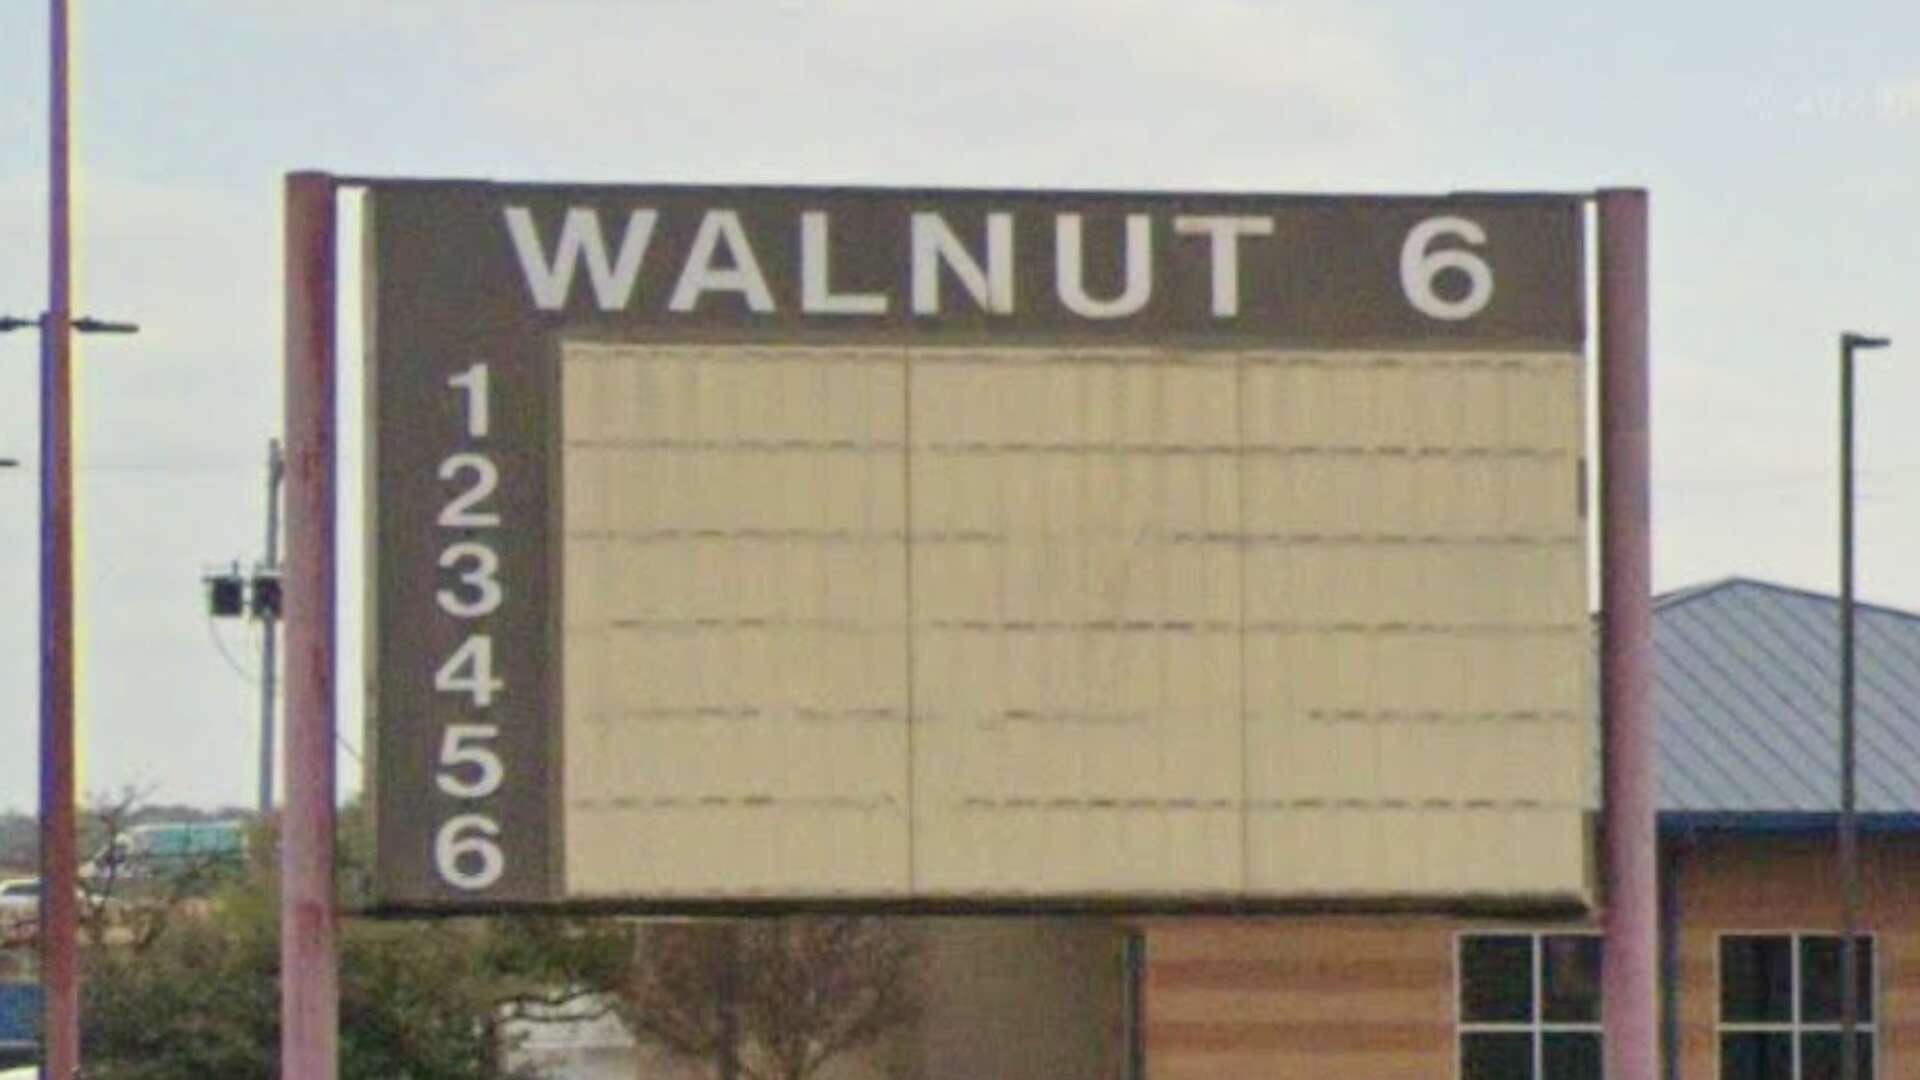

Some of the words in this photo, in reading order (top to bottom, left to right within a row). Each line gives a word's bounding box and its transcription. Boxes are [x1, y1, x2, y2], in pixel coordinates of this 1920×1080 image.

[505, 206, 1273, 318] WALNUT
[1399, 216, 1493, 319] 6
[446, 362, 488, 438] 1
[437, 453, 501, 528] 2
[436, 543, 503, 617] 3
[434, 634, 504, 708] 4
[436, 724, 504, 799] 5
[435, 815, 504, 890] 6
